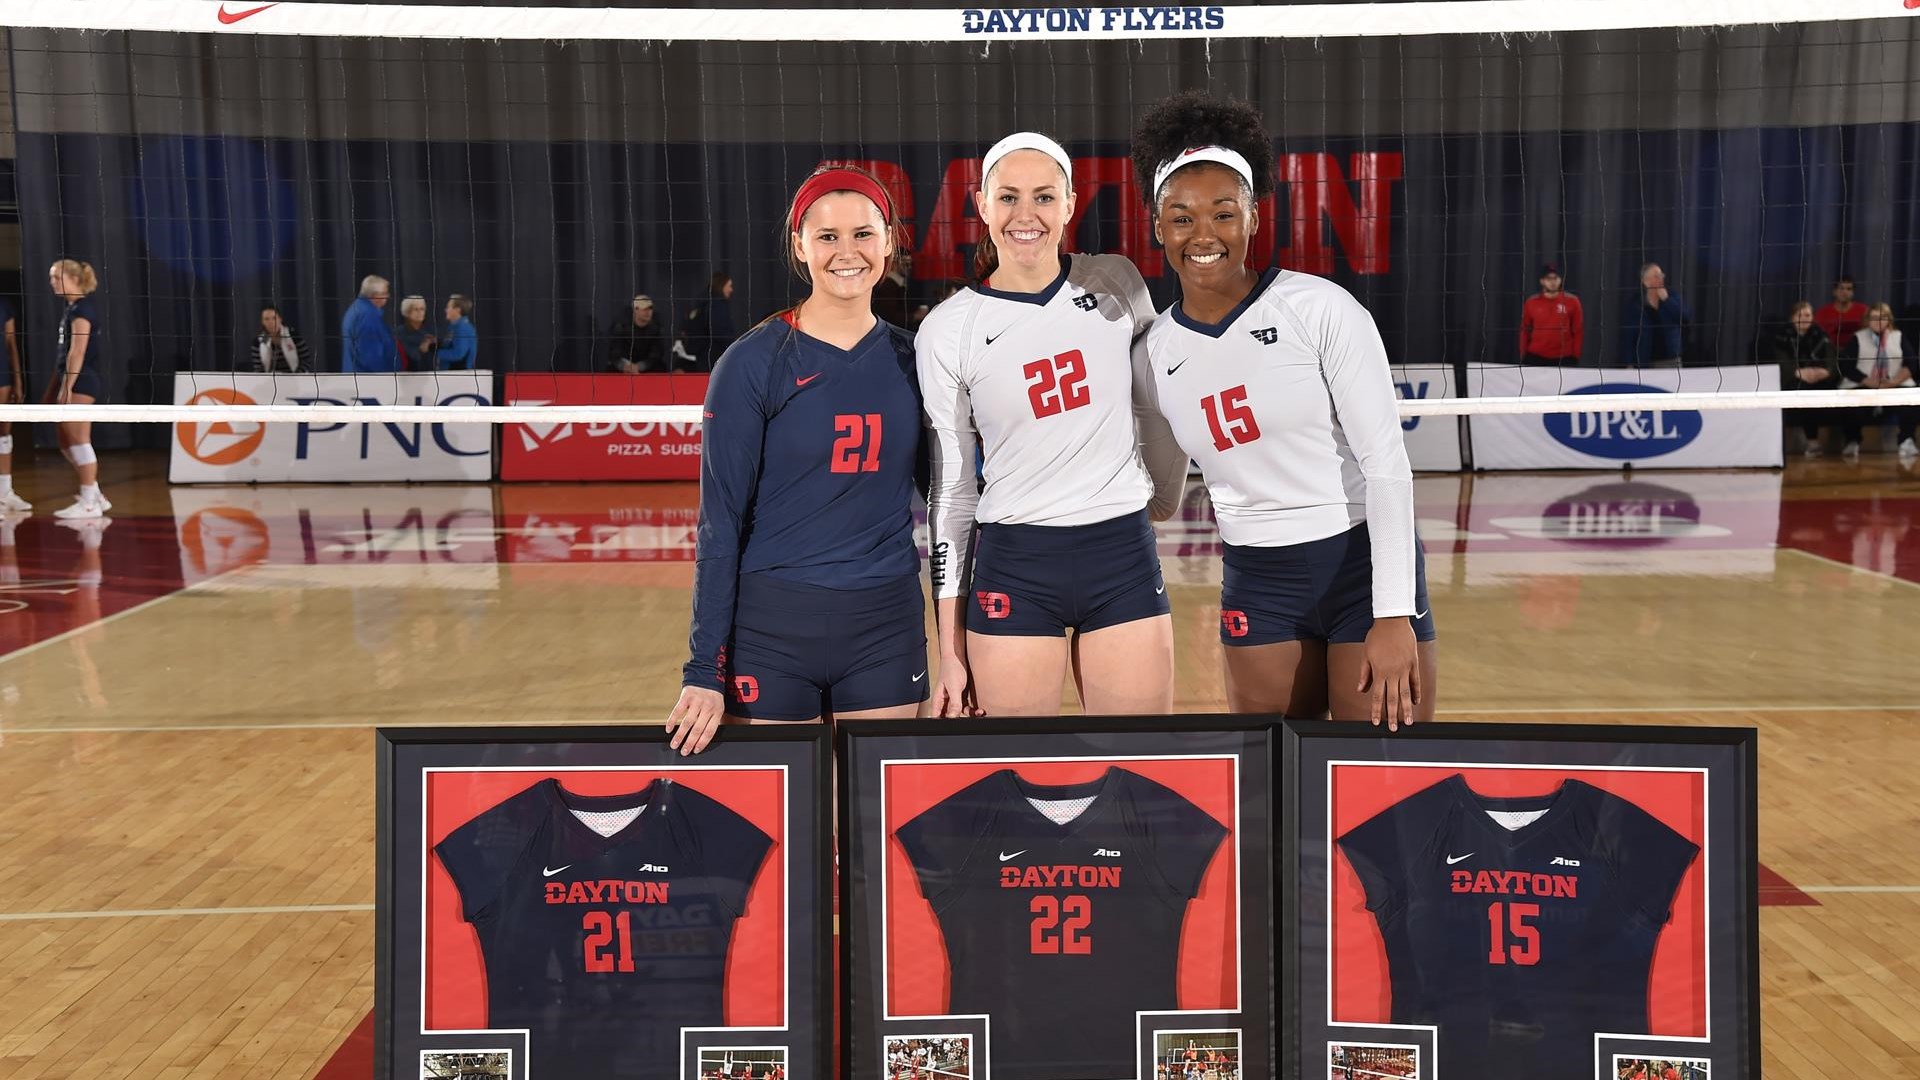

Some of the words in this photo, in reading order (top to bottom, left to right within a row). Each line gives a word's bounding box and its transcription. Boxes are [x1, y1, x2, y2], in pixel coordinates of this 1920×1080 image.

[962, 8, 1091, 34] DAYTON
[1101, 7, 1224, 31] FLYERS
[1023, 349, 1091, 419] 22
[287, 393, 490, 459] PNC
[1200, 384, 1261, 453] 15
[1569, 409, 1678, 440] DP&L
[607, 443, 653, 456] PIZZA
[660, 443, 702, 456] SUBS
[830, 414, 882, 474] 21
[931, 541, 949, 587] FLYERS
[638, 863, 669, 873] A10
[1092, 848, 1121, 857] A10
[1550, 856, 1581, 867] A10
[544, 880, 669, 904] DAYTON
[1000, 865, 1122, 888] DAYTON
[1450, 870, 1578, 898] DAYTON
[1030, 895, 1091, 954] 22
[1488, 902, 1541, 966] 15
[583, 911, 635, 973] 21
